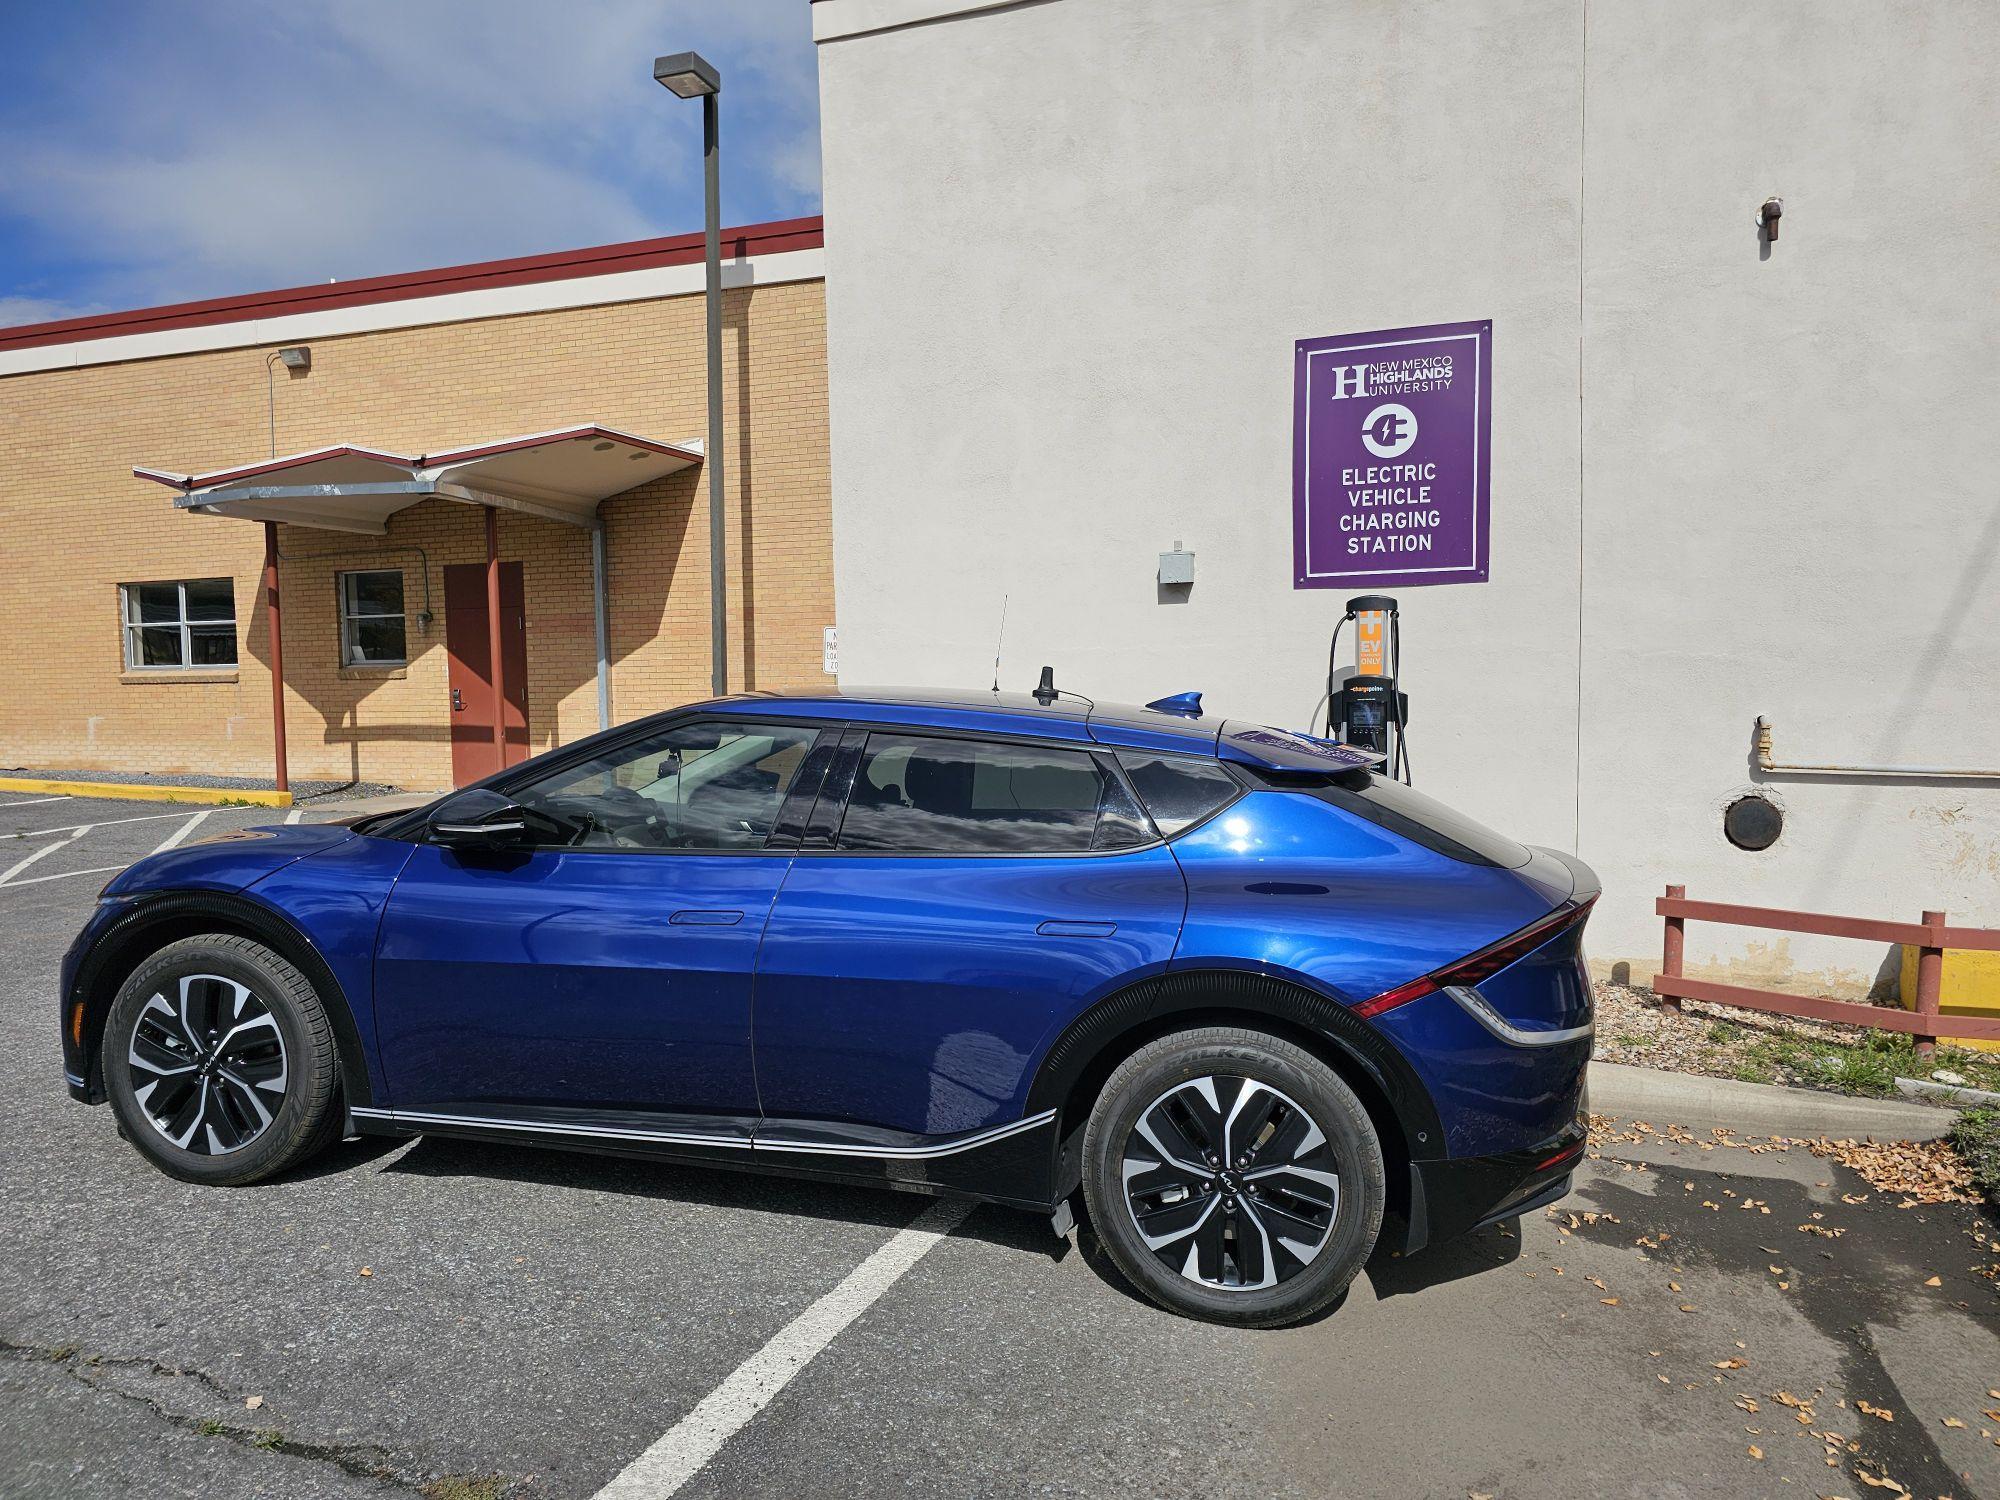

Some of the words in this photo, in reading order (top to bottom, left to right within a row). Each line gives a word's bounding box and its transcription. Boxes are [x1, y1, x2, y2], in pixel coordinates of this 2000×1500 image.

[1369, 361, 1400, 373] NEW
[1402, 355, 1453, 370] MEXICO
[1331, 364, 1370, 400] H
[1369, 366, 1453, 385] HIGHLANDS
[1369, 379, 1452, 397] UNIVERSITY
[1342, 463, 1437, 486] ELECTRIC
[1348, 486, 1431, 507] VEHICLE
[1339, 510, 1440, 532] CHARGING
[1347, 534, 1432, 554] STATION
[1360, 640, 1381, 653] EV
[1360, 657, 1381, 665] ONLY
